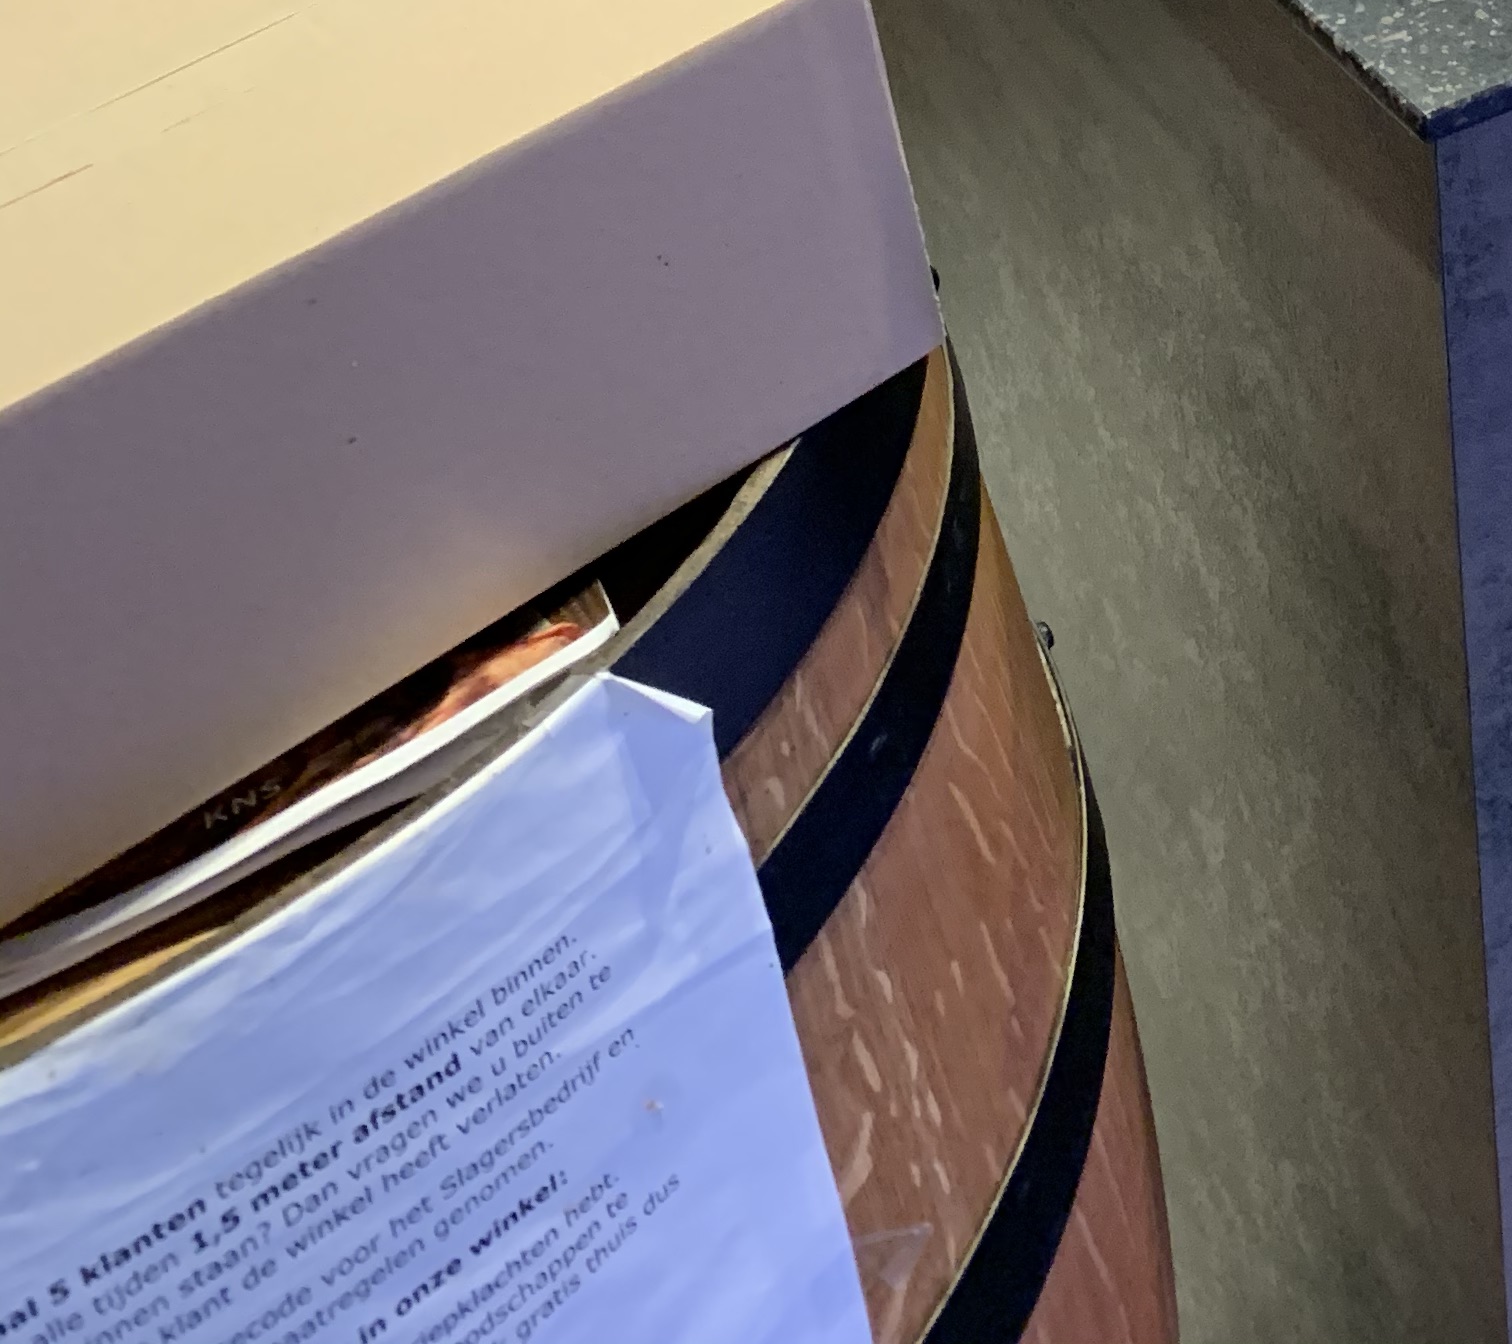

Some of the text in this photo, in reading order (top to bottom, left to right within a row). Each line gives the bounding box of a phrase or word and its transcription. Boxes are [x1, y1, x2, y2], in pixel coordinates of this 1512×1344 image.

[49, 1277, 70, 1307] 5
[79, 1197, 207, 1288] klanten
[215, 1121, 323, 1200] tegelijk
[329, 1098, 355, 1126] in
[362, 1069, 397, 1101] de
[402, 998, 486, 1071] winkel
[491, 935, 577, 1006] binnen.
[92, 1252, 180, 1316] tijden
[192, 1206, 241, 1255] 1,5
[250, 1139, 344, 1213] meter
[352, 1052, 463, 1145] afstand
[469, 1016, 515, 1057] van
[521, 950, 597, 1017] elkaar.
[157, 1050, 563, 1344] klant de winkel heeft verlaten.
[178, 1220, 273, 1299] staan?
[282, 1181, 339, 1228] Dan
[347, 1107, 439, 1181] vragen
[445, 1076, 484, 1110] we
[490, 1056, 508, 1078] u
[512, 991, 584, 1059] buiten
[588, 965, 612, 992] te
[320, 1232, 381, 1288] voor
[388, 1195, 435, 1239] het
[438, 1049, 602, 1201] Slagersbedrijf
[433, 1141, 554, 1243] genomen.
[563, 1172, 620, 1228] hebt.
[606, 1192, 628, 1219] te
[395, 1257, 463, 1318] onze
[467, 1169, 569, 1258] winkel:
[515, 1172, 680, 1344] gratis thuis dus
